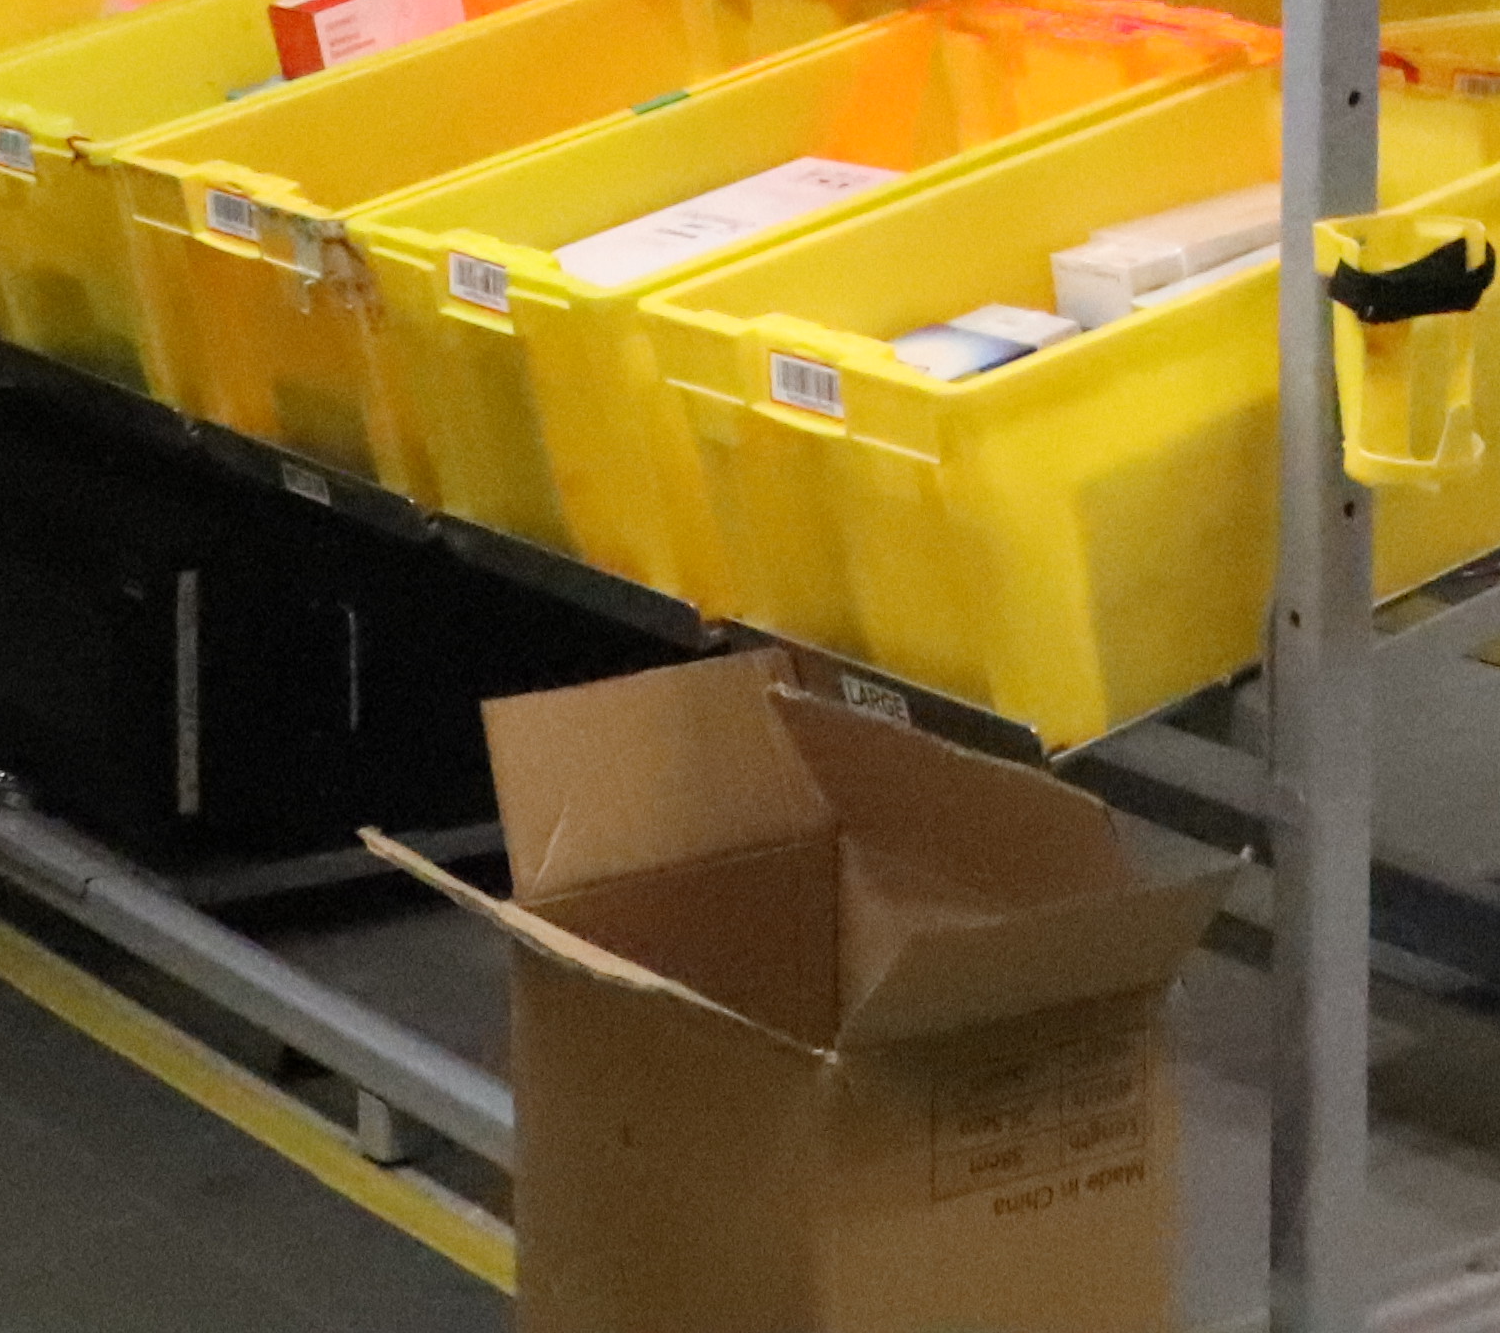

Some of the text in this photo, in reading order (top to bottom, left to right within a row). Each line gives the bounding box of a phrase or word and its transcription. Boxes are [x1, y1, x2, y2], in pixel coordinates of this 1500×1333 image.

[847, 680, 907, 720] LARGE
[993, 1156, 1145, 1217] Made in China
